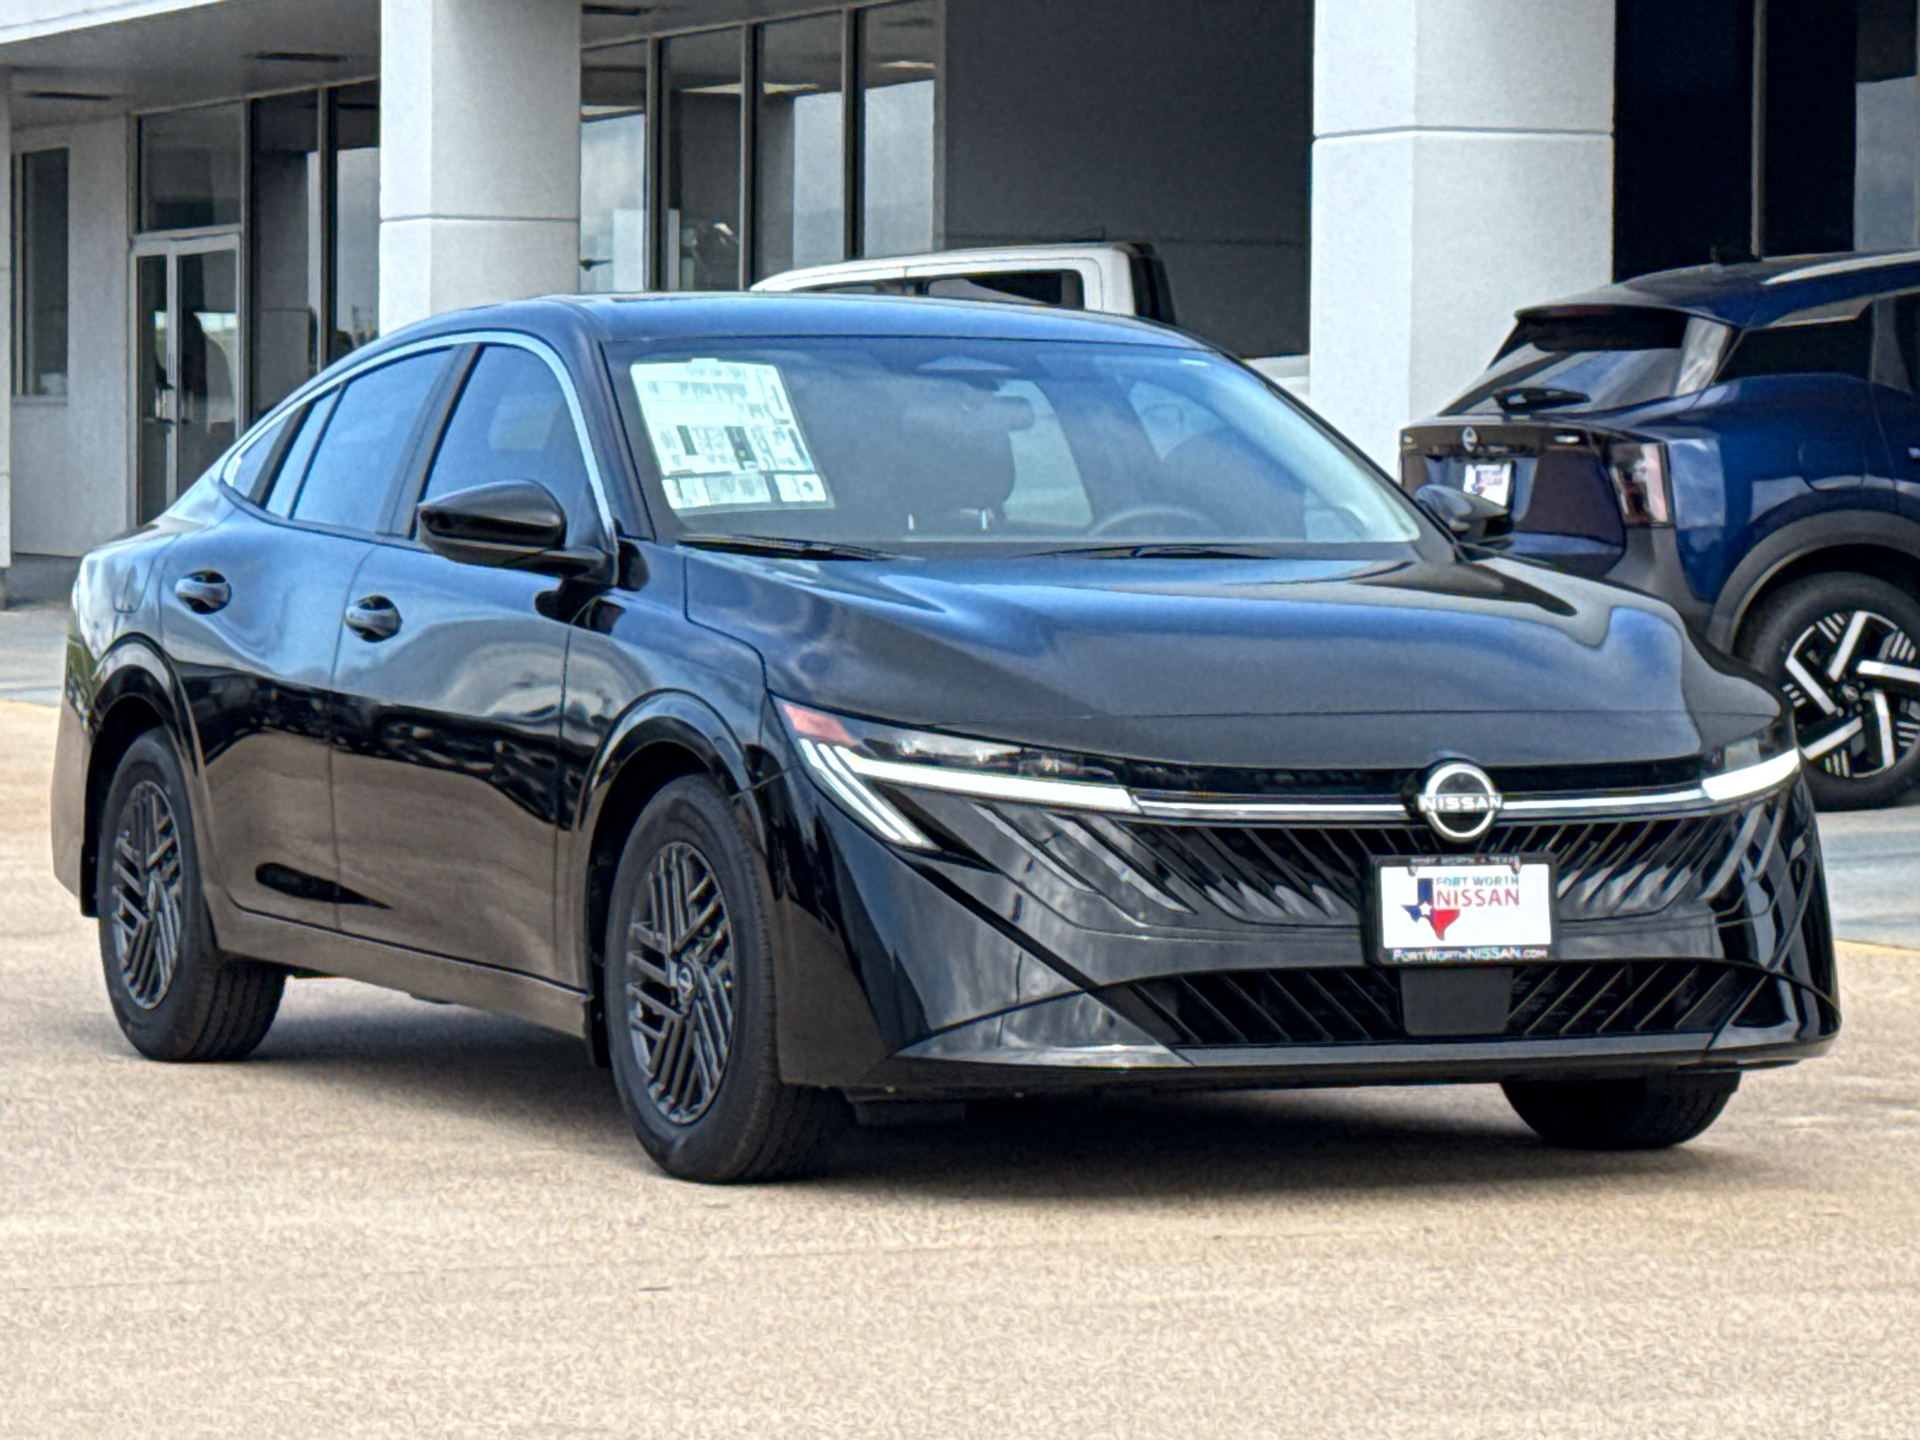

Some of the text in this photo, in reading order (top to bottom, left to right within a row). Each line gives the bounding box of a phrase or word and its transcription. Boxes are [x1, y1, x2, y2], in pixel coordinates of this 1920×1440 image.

[1418, 795, 1502, 812] NISSAN
[1435, 875, 1519, 887] FORT WORTH
[1436, 888, 1520, 908] NISSAN
